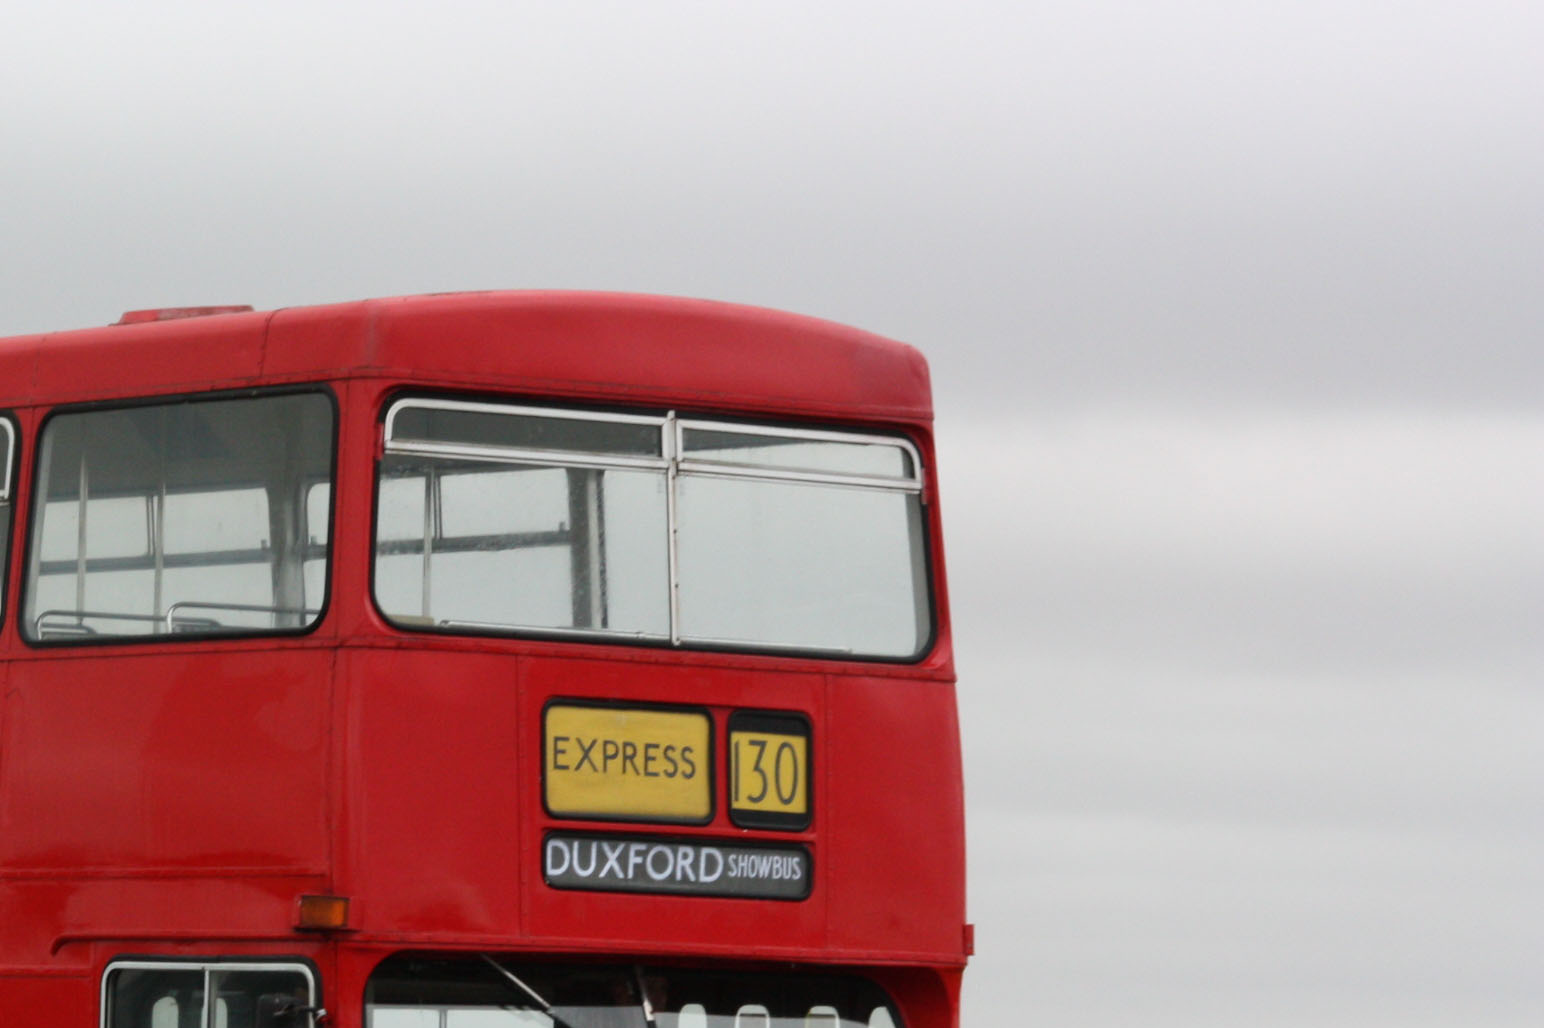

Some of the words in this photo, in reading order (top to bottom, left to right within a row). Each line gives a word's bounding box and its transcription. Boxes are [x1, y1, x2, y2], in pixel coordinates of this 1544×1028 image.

[552, 736, 696, 780] EXPRESS
[733, 739, 799, 806] 130
[546, 839, 724, 883] DUXFORD
[727, 853, 802, 881] SHOWBUS
